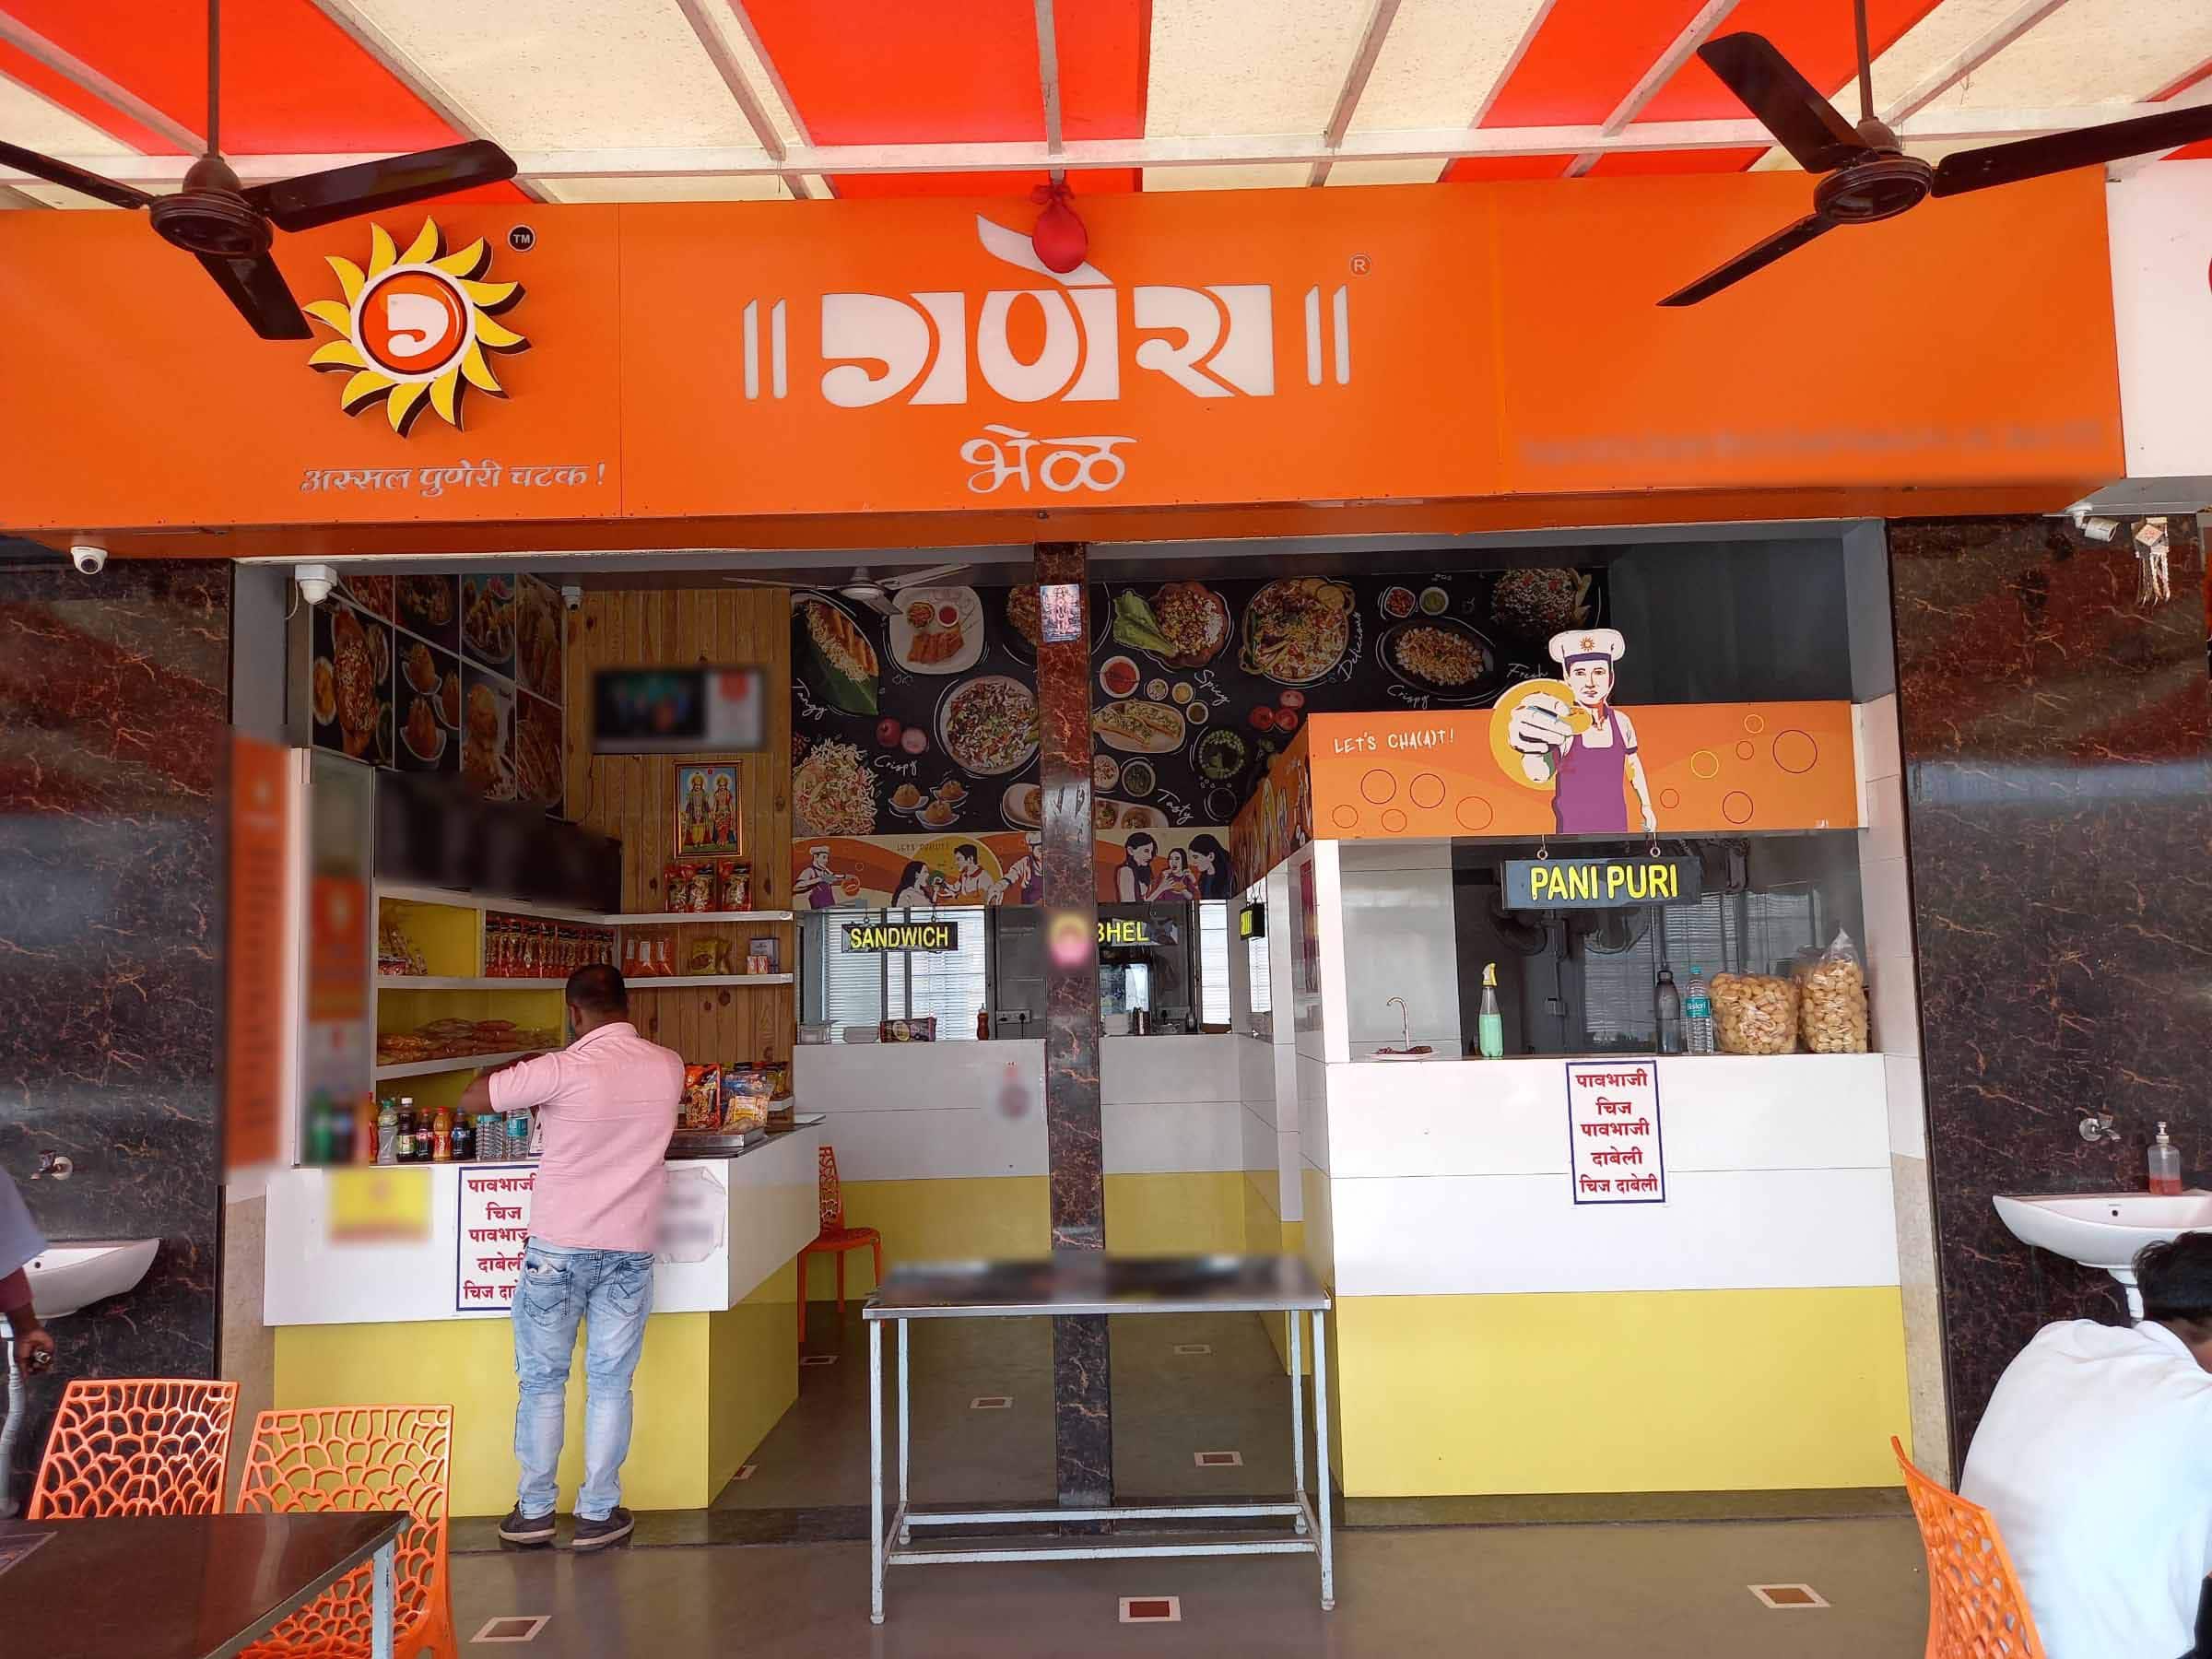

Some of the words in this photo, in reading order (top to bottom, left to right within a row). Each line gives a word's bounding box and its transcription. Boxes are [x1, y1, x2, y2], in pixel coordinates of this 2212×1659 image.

[513, 232, 531, 244] TM
[959, 423, 1138, 494] भेळ
[300, 467, 414, 493] अस्सल
[418, 457, 502, 499] पुणेरी
[508, 464, 591, 488] चटक
[1194, 669, 1231, 707] Spicy
[1386, 684, 1430, 711] Crispy
[1334, 732, 1378, 754] LET'S
[874, 754, 920, 777] Crispy
[1157, 787, 1195, 826] Tasty
[1530, 865, 1599, 901] PANI
[1606, 863, 1679, 900] PURI
[850, 925, 949, 948] SANDWICH
[1574, 1068, 1648, 1088] पावभाजी
[1594, 1096, 1632, 1116] चिज
[1580, 1117, 1651, 1137] पावभाजी
[1590, 1146, 1644, 1168] दाबेली
[1579, 1173, 1611, 1194] चिज
[1614, 1172, 1659, 1194] दाबेली
[485, 1201, 524, 1220] चिज
[463, 1279, 495, 1300] चिज
